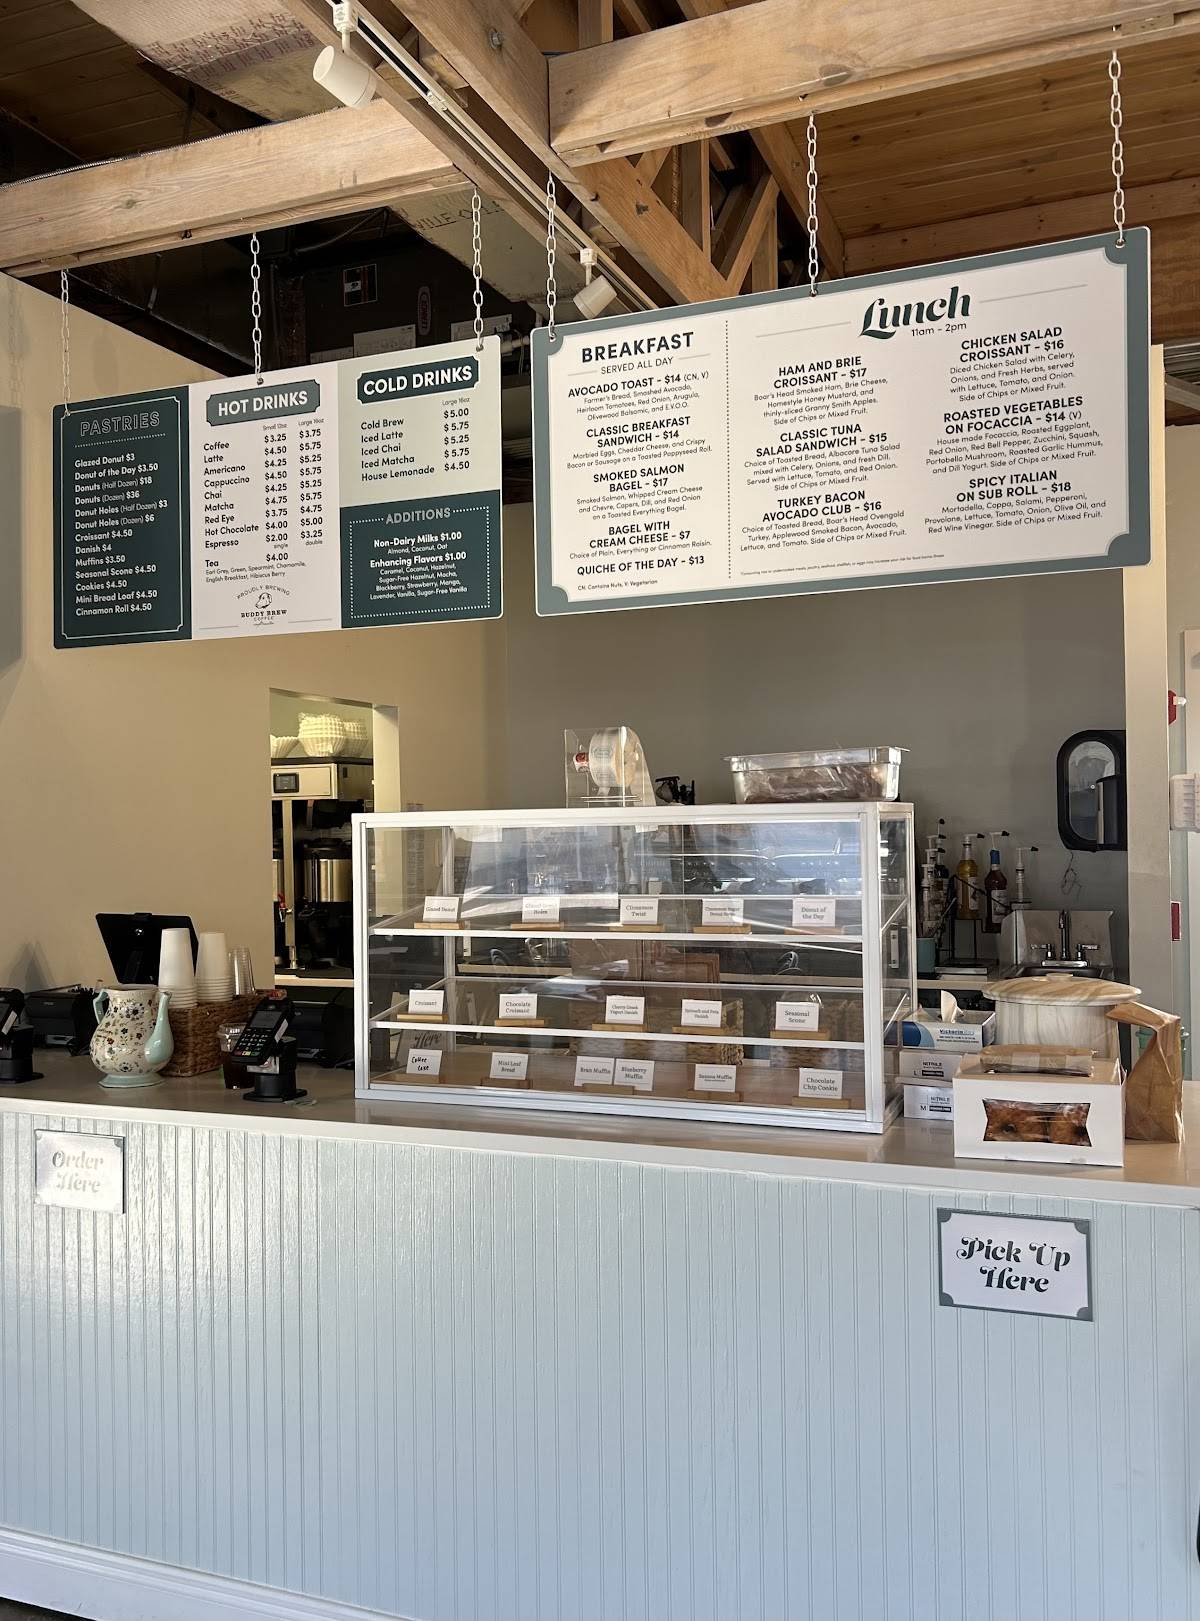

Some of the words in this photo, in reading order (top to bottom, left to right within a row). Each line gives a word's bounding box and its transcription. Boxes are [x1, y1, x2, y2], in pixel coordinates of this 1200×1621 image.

[859, 286, 970, 339] Lunch
[911, 327, 934, 336] 11am
[945, 323, 966, 333] 2pm
[961, 333, 1016, 350] CHICKEN
[1020, 326, 1062, 341] SALAD
[582, 331, 694, 363] BREAKFAST
[601, 362, 634, 374] SERVED
[636, 360, 652, 369] ALL
[655, 356, 673, 366] DAY
[779, 364, 805, 376] HAM
[808, 360, 832, 372] AND
[836, 356, 861, 368] BRIE
[363, 375, 407, 395] COLD
[412, 365, 472, 388] DRINKS
[568, 382, 618, 397] AVOCADO
[620, 377, 654, 390] TOAST
[664, 373, 681, 388] $14
[683, 373, 699, 386] (CN,
[218, 399, 249, 416] HOT
[253, 390, 307, 412] DRINKS
[584, 395, 610, 404] Farmer's
[633, 387, 662, 397] Smashed
[443, 407, 469, 419] $5.00
[827, 409, 849, 418] Mixed
[850, 407, 868, 415] Fruit.
[80, 411, 160, 436] PASTRIES
[360, 419, 380, 430] Cold
[382, 419, 404, 427] Brew
[443, 421, 469, 432] $5.75
[586, 424, 628, 438] CLASSIC
[632, 415, 690, 432] BREAKFAST
[264, 433, 286, 444] $3.25
[299, 428, 321, 439] $3.75
[361, 432, 379, 443] Iced
[381, 431, 403, 440] Latte
[203, 441, 229, 451] Coffee
[264, 445, 287, 456] $4.50
[299, 441, 321, 451] $5.75
[74, 457, 100, 468] Glazed
[102, 454, 124, 464] Donut
[125, 453, 135, 462] $3
[203, 454, 224, 463] Latte
[444, 460, 470, 472] $4.50
[74, 470, 96, 480] Donut
[98, 468, 106, 477] of
[107, 467, 120, 476] the
[121, 466, 136, 475] Day
[137, 462, 158, 473] $3.50
[361, 473, 388, 481] House
[390, 465, 434, 478] Lemonade
[593, 469, 637, 483] SMOKED
[640, 463, 684, 477] SALMON
[969, 475, 1006, 488] SPICY
[1010, 470, 1057, 484] ITALIAN
[777, 495, 821, 508] TURKEY
[825, 490, 865, 503] BACON
[956, 491, 974, 502] ON
[978, 488, 1002, 500] SUB
[1006, 485, 1038, 497] ROLL
[1051, 481, 1071, 493] $18
[385, 507, 453, 524] ADDITIONS
[762, 507, 818, 522] AVOCADO
[821, 504, 851, 516] CLUB
[863, 501, 881, 512] $16
[75, 520, 97, 529] Donut
[98, 518, 119, 527] Holes
[120, 515, 144, 526] (Dozen)
[145, 513, 154, 523] $6
[265, 520, 288, 530] $4.00
[300, 516, 322, 526] $5.00
[74, 531, 110, 542] Croissant
[111, 528, 132, 538] $4.50
[204, 528, 218, 536] Hot
[220, 524, 259, 535] Chocolate
[265, 533, 288, 542] $2.00
[300, 529, 322, 539] $3.25
[205, 539, 239, 550] Espresso
[374, 536, 415, 548] Non-Dairy
[417, 534, 438, 543] Milks
[440, 531, 462, 541] $1.00
[75, 557, 104, 567] Muffins
[105, 554, 125, 564] $3.50
[204, 559, 218, 567] Tea
[266, 552, 288, 562] $4.00
[75, 568, 109, 579] Seasonal
[110, 567, 133, 576] Scone
[134, 564, 156, 574] $4.50
[577, 563, 615, 576] QUICHE
[618, 561, 632, 572] OF
[634, 559, 654, 570] THE
[657, 557, 678, 568] DAY
[688, 555, 704, 566] $13
[75, 594, 92, 603] Mini
[93, 592, 116, 602] Bread
[117, 591, 135, 600] Loaf
[135, 589, 157, 599] $4.50
[75, 607, 113, 616] Cinnamon
[115, 604, 129, 613] Roll
[130, 602, 152, 612] $4.50
[53, 1150, 104, 1170] Order
[56, 1172, 101, 1192] Here
[956, 1237, 1021, 1262] Pick
[1029, 1242, 1070, 1271] Up
[980, 1266, 1049, 1292] Here
